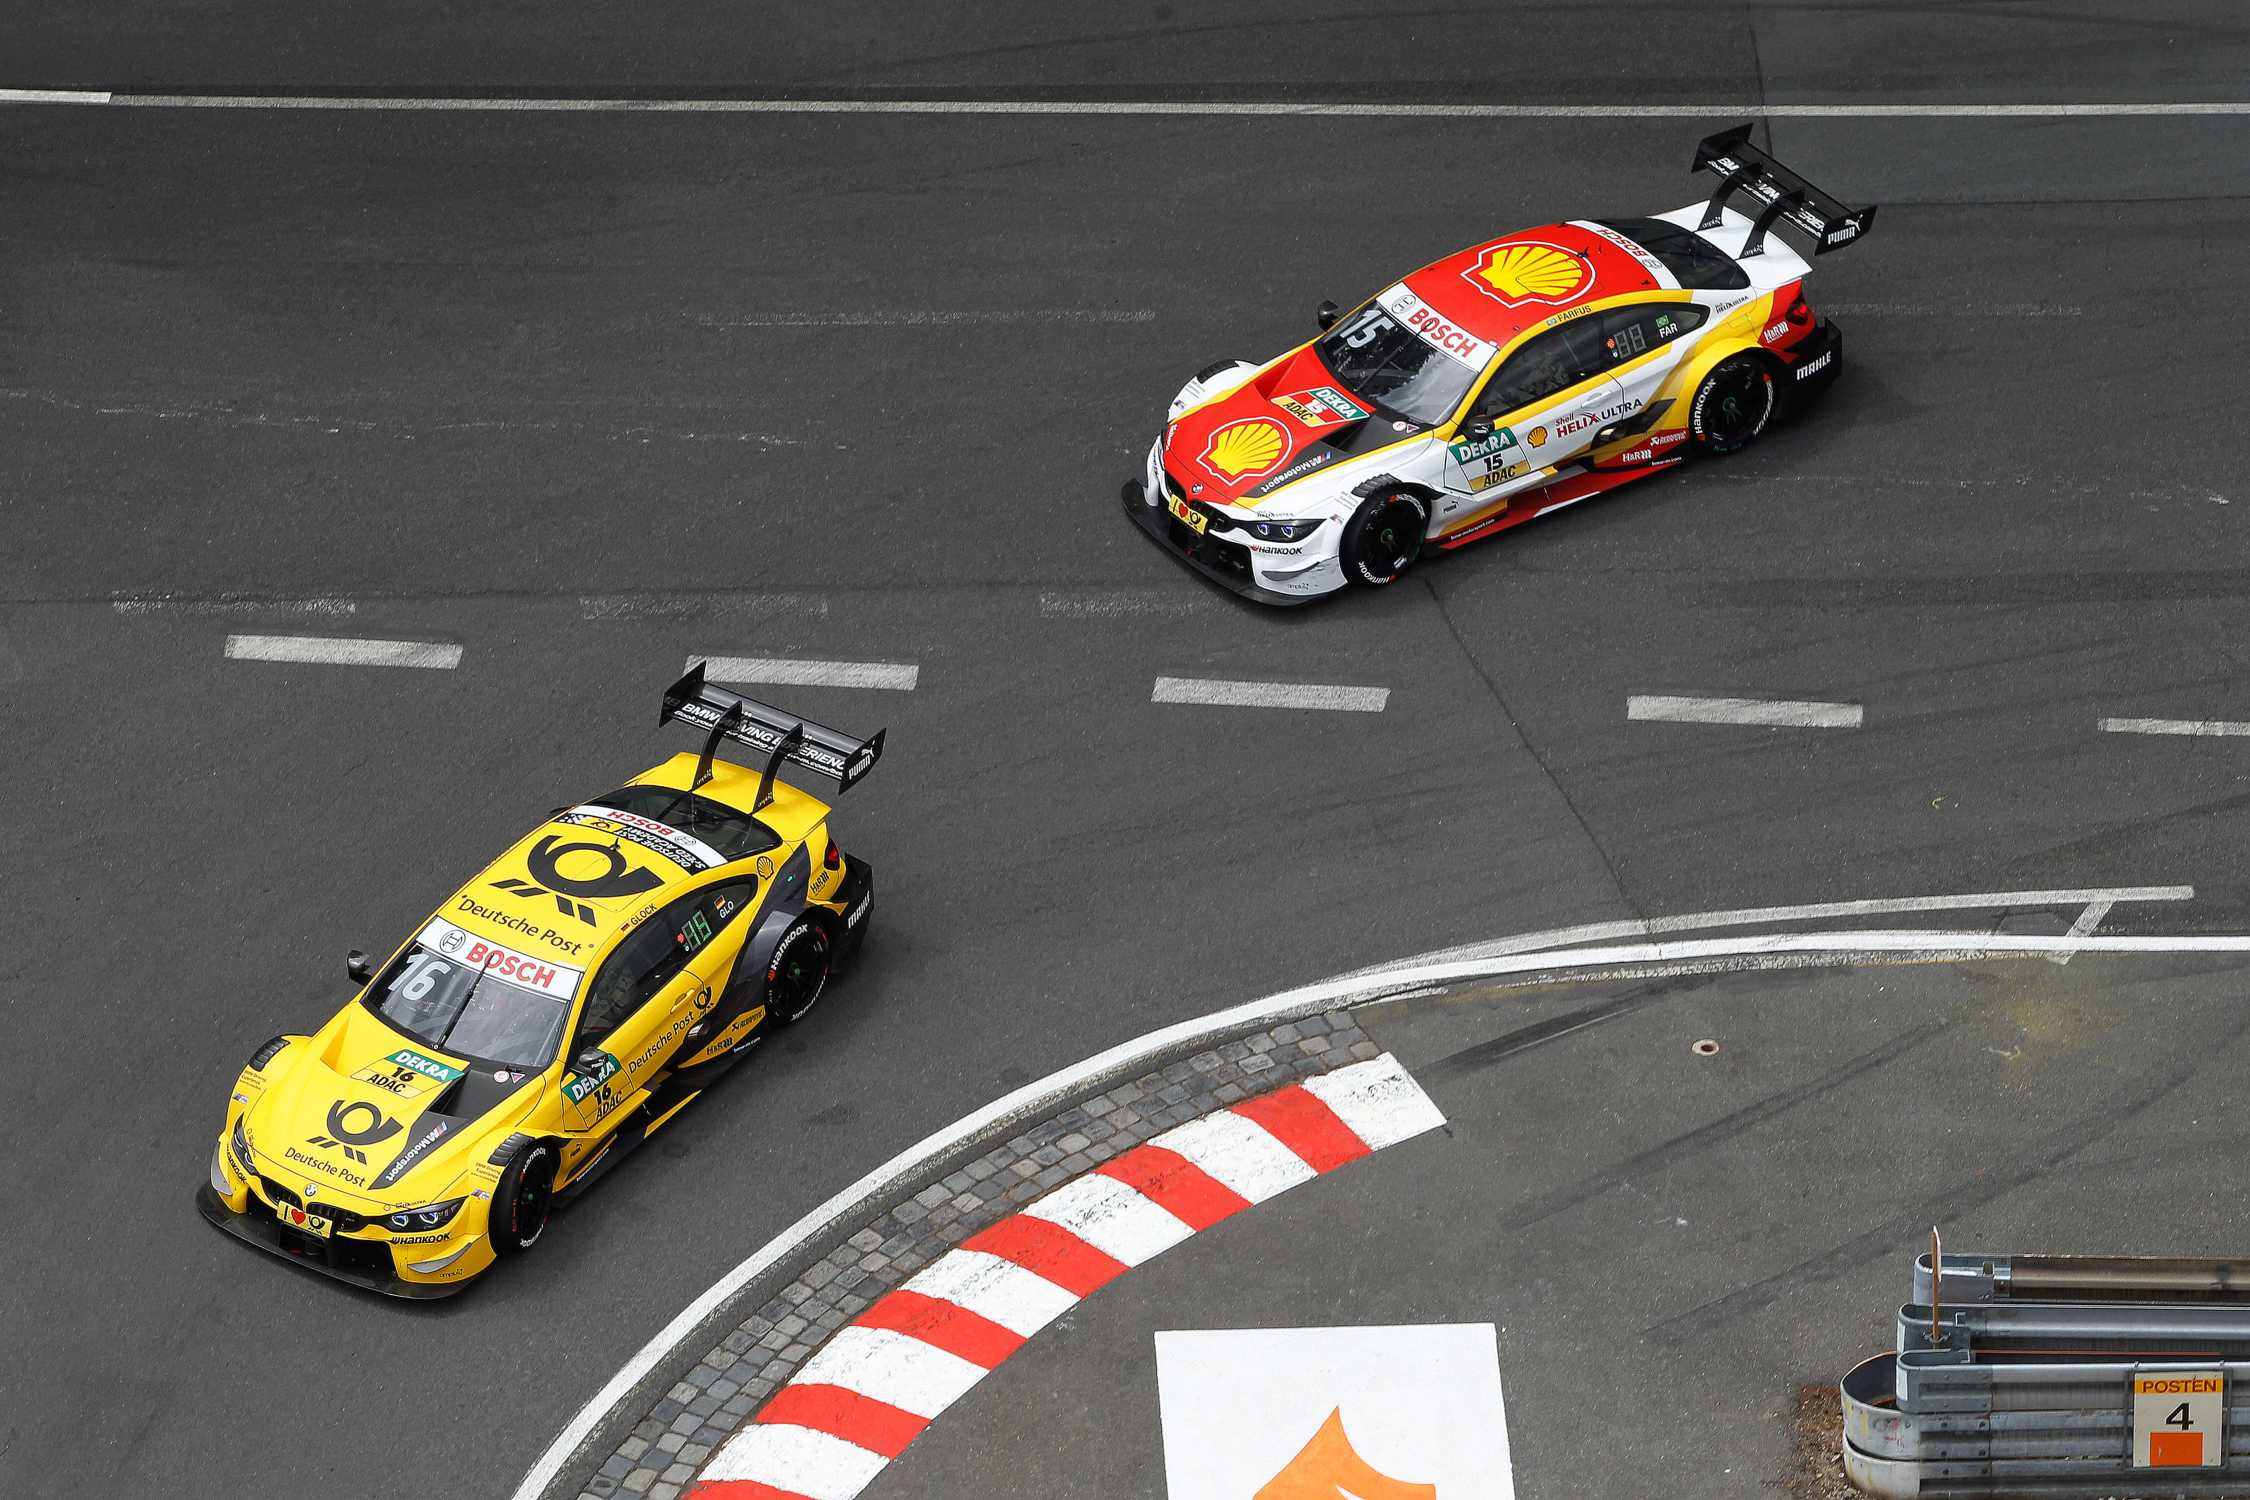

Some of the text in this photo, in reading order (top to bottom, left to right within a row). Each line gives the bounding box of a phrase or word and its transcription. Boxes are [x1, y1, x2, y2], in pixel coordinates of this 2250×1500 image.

[1597, 228, 1648, 257] BOSCH
[1827, 225, 1856, 245] PUMA
[1557, 305, 1592, 322] FARFUS
[1340, 309, 1396, 348] 15
[1407, 307, 1478, 359] BOSCH
[1658, 323, 1679, 339] FAR
[1796, 350, 1832, 381] MAHLE
[1284, 400, 1313, 421] ADAC
[1315, 388, 1358, 418] DEKRA
[1555, 413, 1575, 427] Shell
[1556, 399, 1644, 439] HELIX ULTRA
[1460, 431, 1511, 462] DEKRA
[1261, 459, 1310, 493] Motorsport
[1483, 451, 1504, 473] 15
[1484, 464, 1517, 488] ADAC
[681, 702, 720, 722] BMW
[848, 754, 872, 780] PUMA
[607, 811, 674, 836] BOSCH
[630, 902, 658, 926] GLOCK
[719, 900, 734, 919] GLO
[847, 890, 871, 929] MAHLE
[457, 897, 583, 956] Deutsche Post
[387, 952, 452, 1001] 16
[465, 942, 557, 990] BOSCH
[628, 1010, 695, 1075] Deutsche Post
[390, 1066, 417, 1083] 16
[395, 1051, 450, 1081] DEKRA
[367, 1073, 406, 1094] ADAC
[593, 1083, 612, 1105] 16
[595, 1089, 622, 1121] ADAC
[285, 1147, 366, 1188] Deutsche Post
[385, 1138, 431, 1182] Motorsport
[2142, 1380, 2217, 1394] POSTEN
[2165, 1402, 2195, 1431] 4
